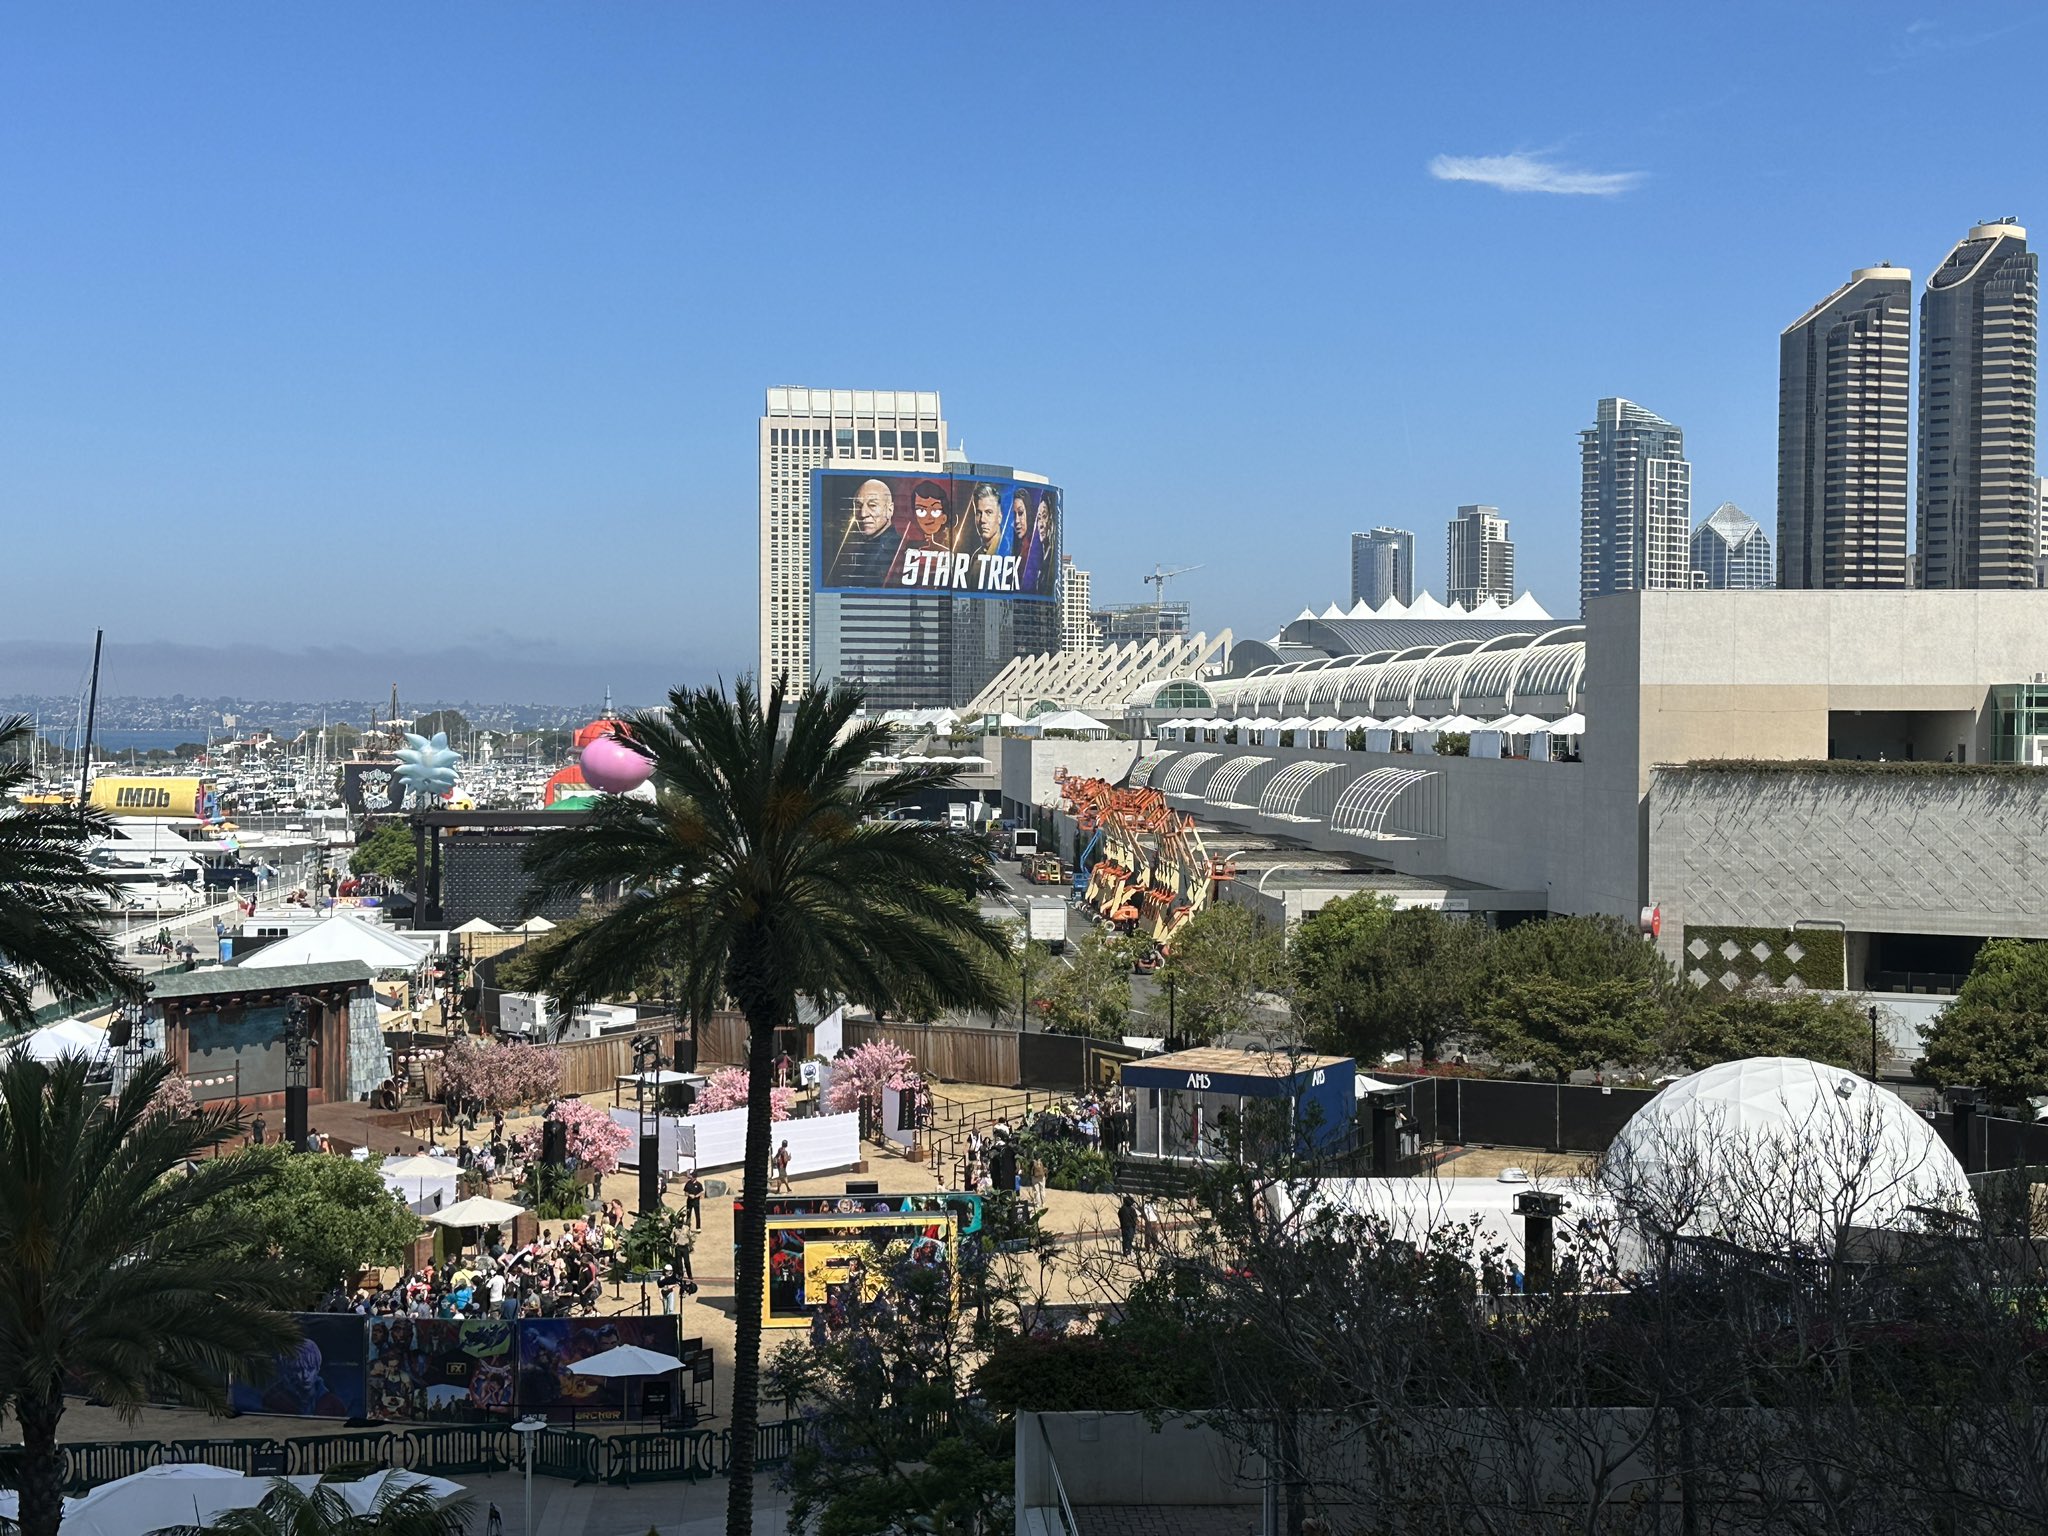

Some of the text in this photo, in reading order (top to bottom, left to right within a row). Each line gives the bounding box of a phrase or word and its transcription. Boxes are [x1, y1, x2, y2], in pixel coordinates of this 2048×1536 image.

[901, 548, 1022, 591] STAR TREK
[116, 787, 171, 808] IMDb
[1186, 1072, 1211, 1090] AHS
[450, 1364, 462, 1373] FX
